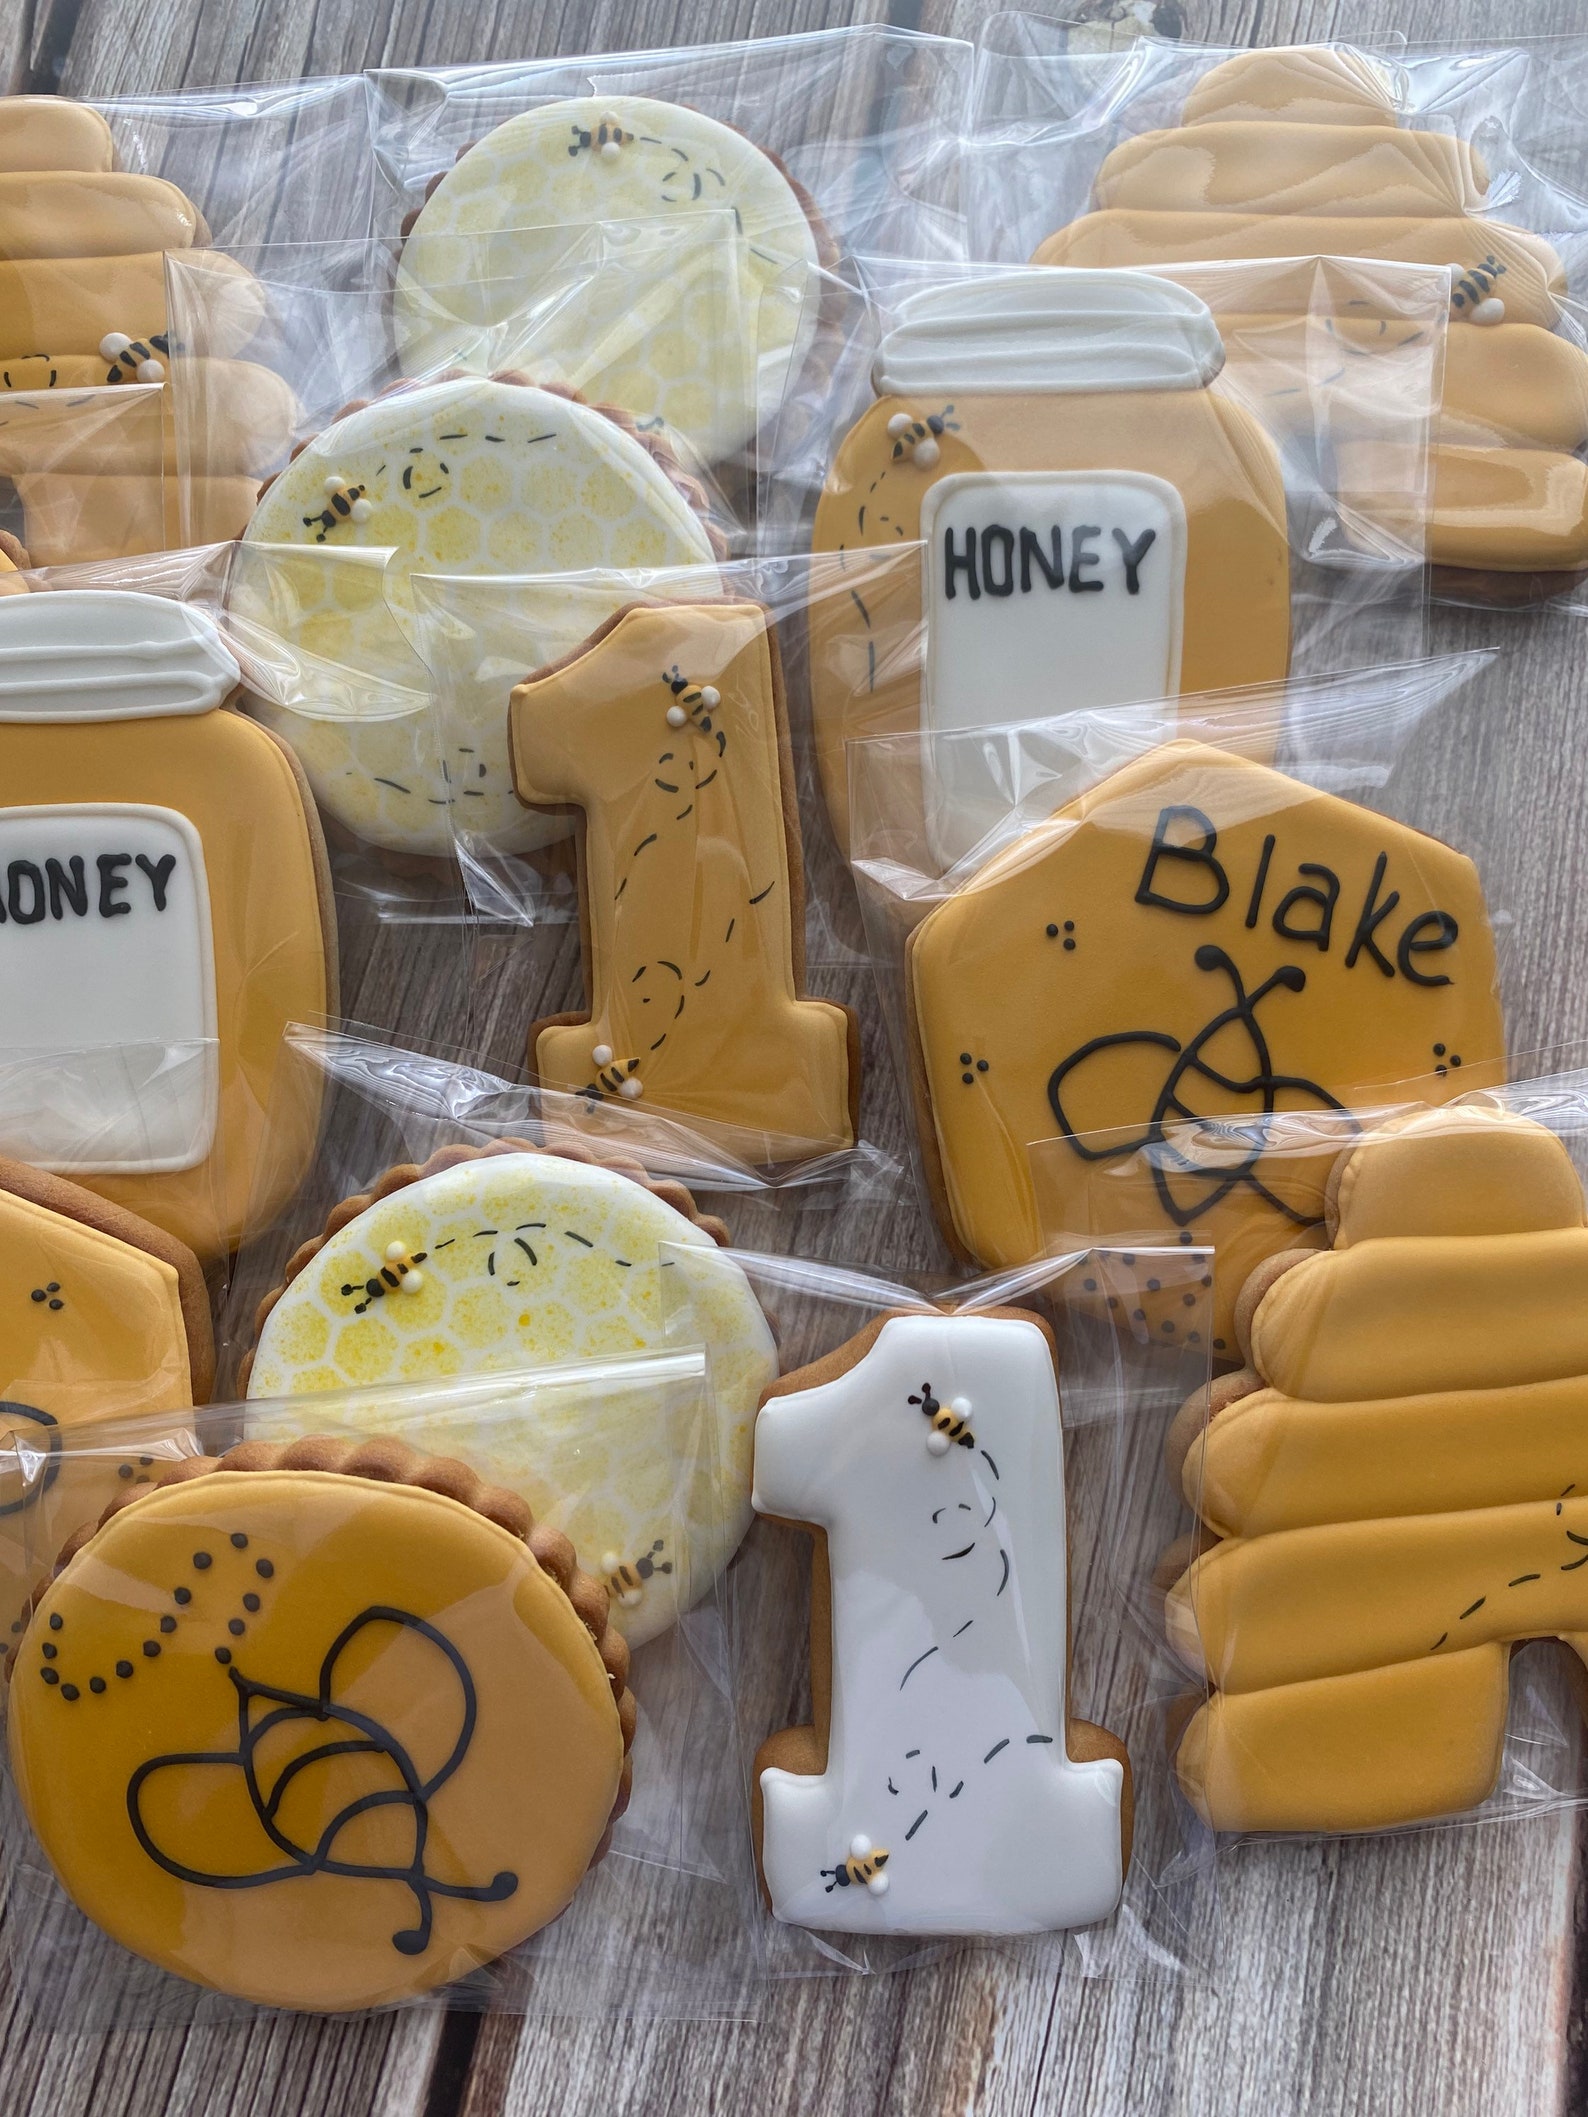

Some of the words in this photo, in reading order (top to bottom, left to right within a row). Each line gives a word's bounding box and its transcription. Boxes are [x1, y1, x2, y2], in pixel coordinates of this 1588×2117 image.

[944, 524, 1156, 600] HONEY
[0, 852, 177, 926] ONEY
[1134, 805, 1461, 988] Blake
